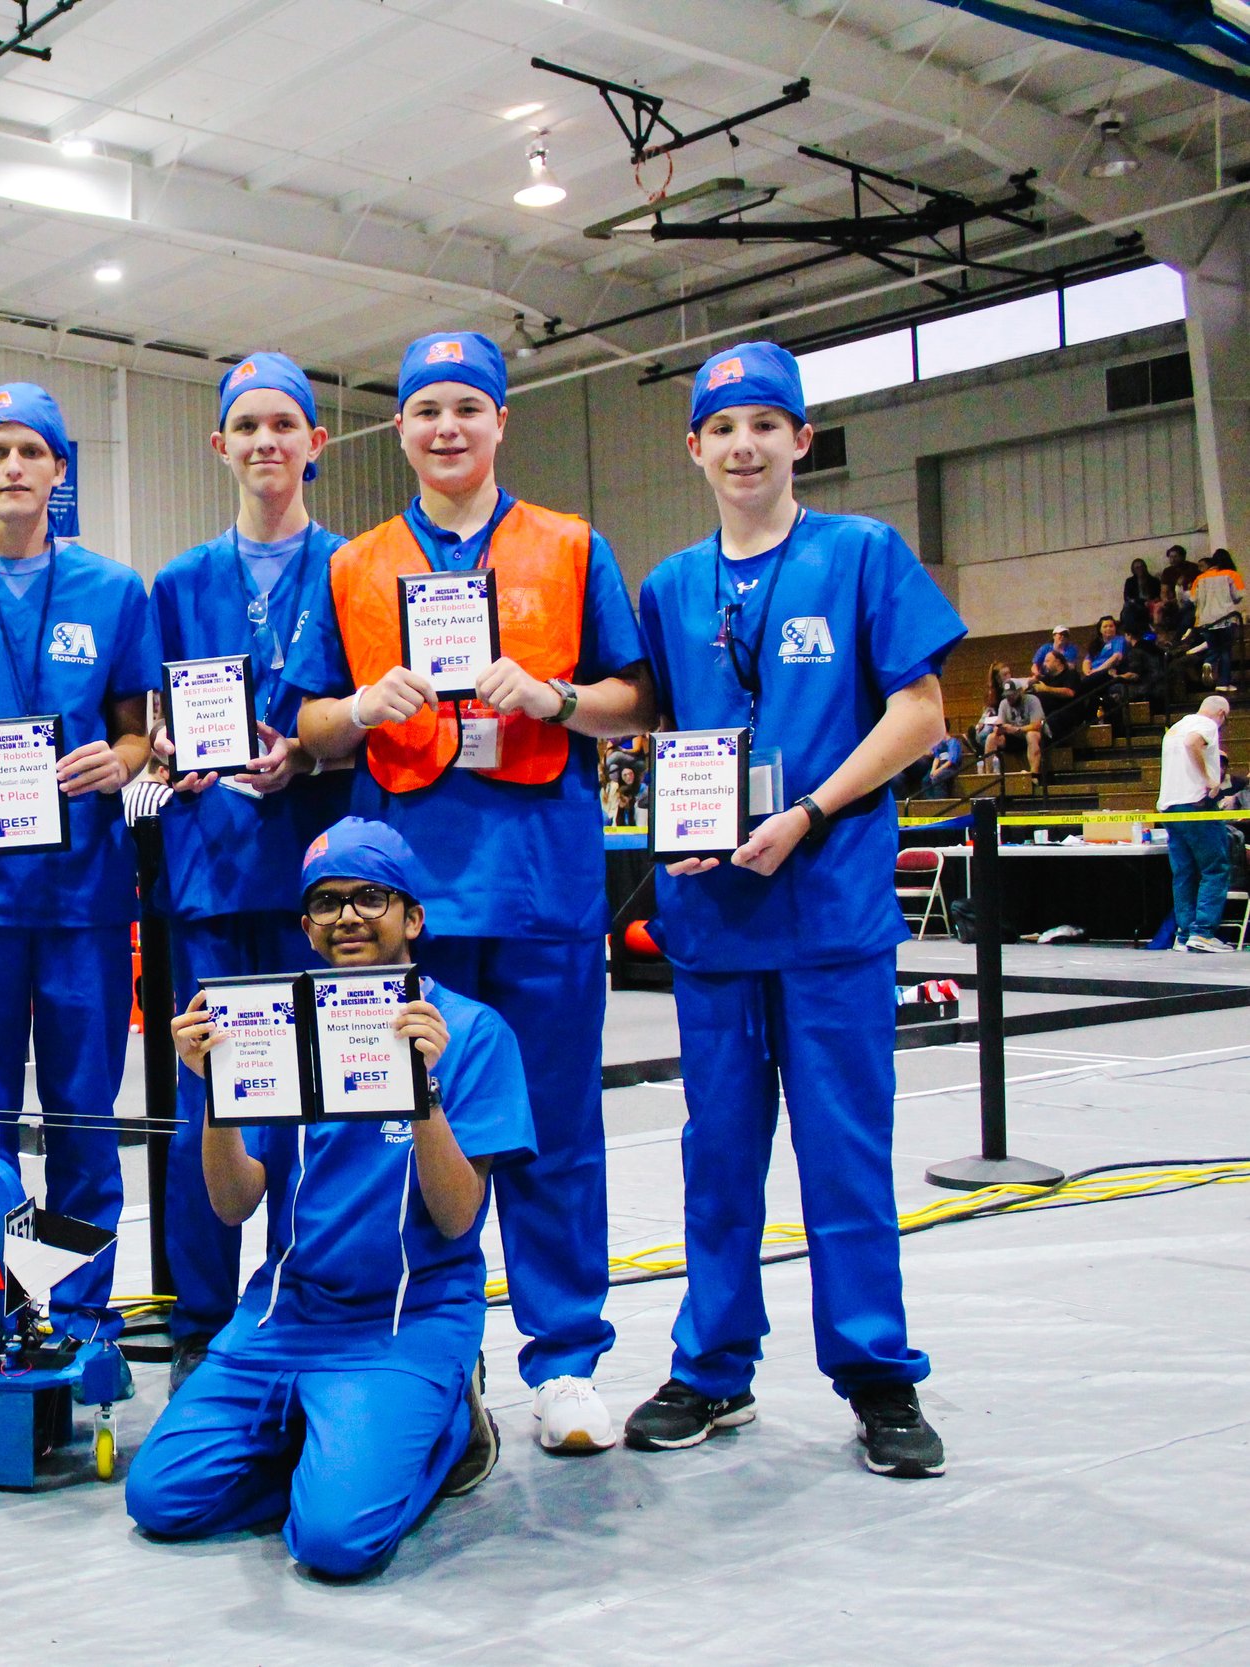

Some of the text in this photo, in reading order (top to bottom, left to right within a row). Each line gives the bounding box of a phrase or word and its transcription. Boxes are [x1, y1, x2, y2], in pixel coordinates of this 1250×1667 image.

[420, 603, 476, 613] BEST Robotics
[414, 614, 483, 628] Safety Award
[423, 634, 477, 647] 3rd Place
[51, 654, 95, 665] ROBOTICS
[439, 655, 471, 665] BEST
[782, 655, 832, 664] ROBOTICS
[183, 685, 234, 696] BEST Robotics
[186, 696, 233, 708] Teamwork
[196, 709, 225, 720] Award
[188, 723, 236, 735] 3rd Place
[203, 738, 232, 748] BEST
[3, 750, 43, 761] Robotics
[20, 763, 48, 772] Award
[668, 761, 688, 769] BEST
[681, 773, 713, 781] Robot
[8, 791, 39, 801] Place
[658, 785, 735, 797] Craftsmanship
[670, 801, 722, 812] 1st Place
[1, 816, 37, 828] BEST
[684, 818, 717, 828] BEST
[1125, 814, 1147, 822] ENTER
[347, 989, 375, 998] INCISION
[341, 996, 381, 1006] DECISION 2023
[237, 1011, 264, 1019] INCISION
[330, 1007, 394, 1018] BEST Robotics
[231, 1018, 271, 1027] DECISION 2023
[327, 1023, 350, 1032] Most
[244, 1027, 287, 1038] Robotics
[235, 1040, 271, 1048] Engineering
[349, 1035, 380, 1045] Design
[340, 1052, 391, 1063] 1st Place
[236, 1059, 274, 1068] 3rd Place
[353, 1071, 389, 1082] BEST
[243, 1078, 277, 1089] BEST
